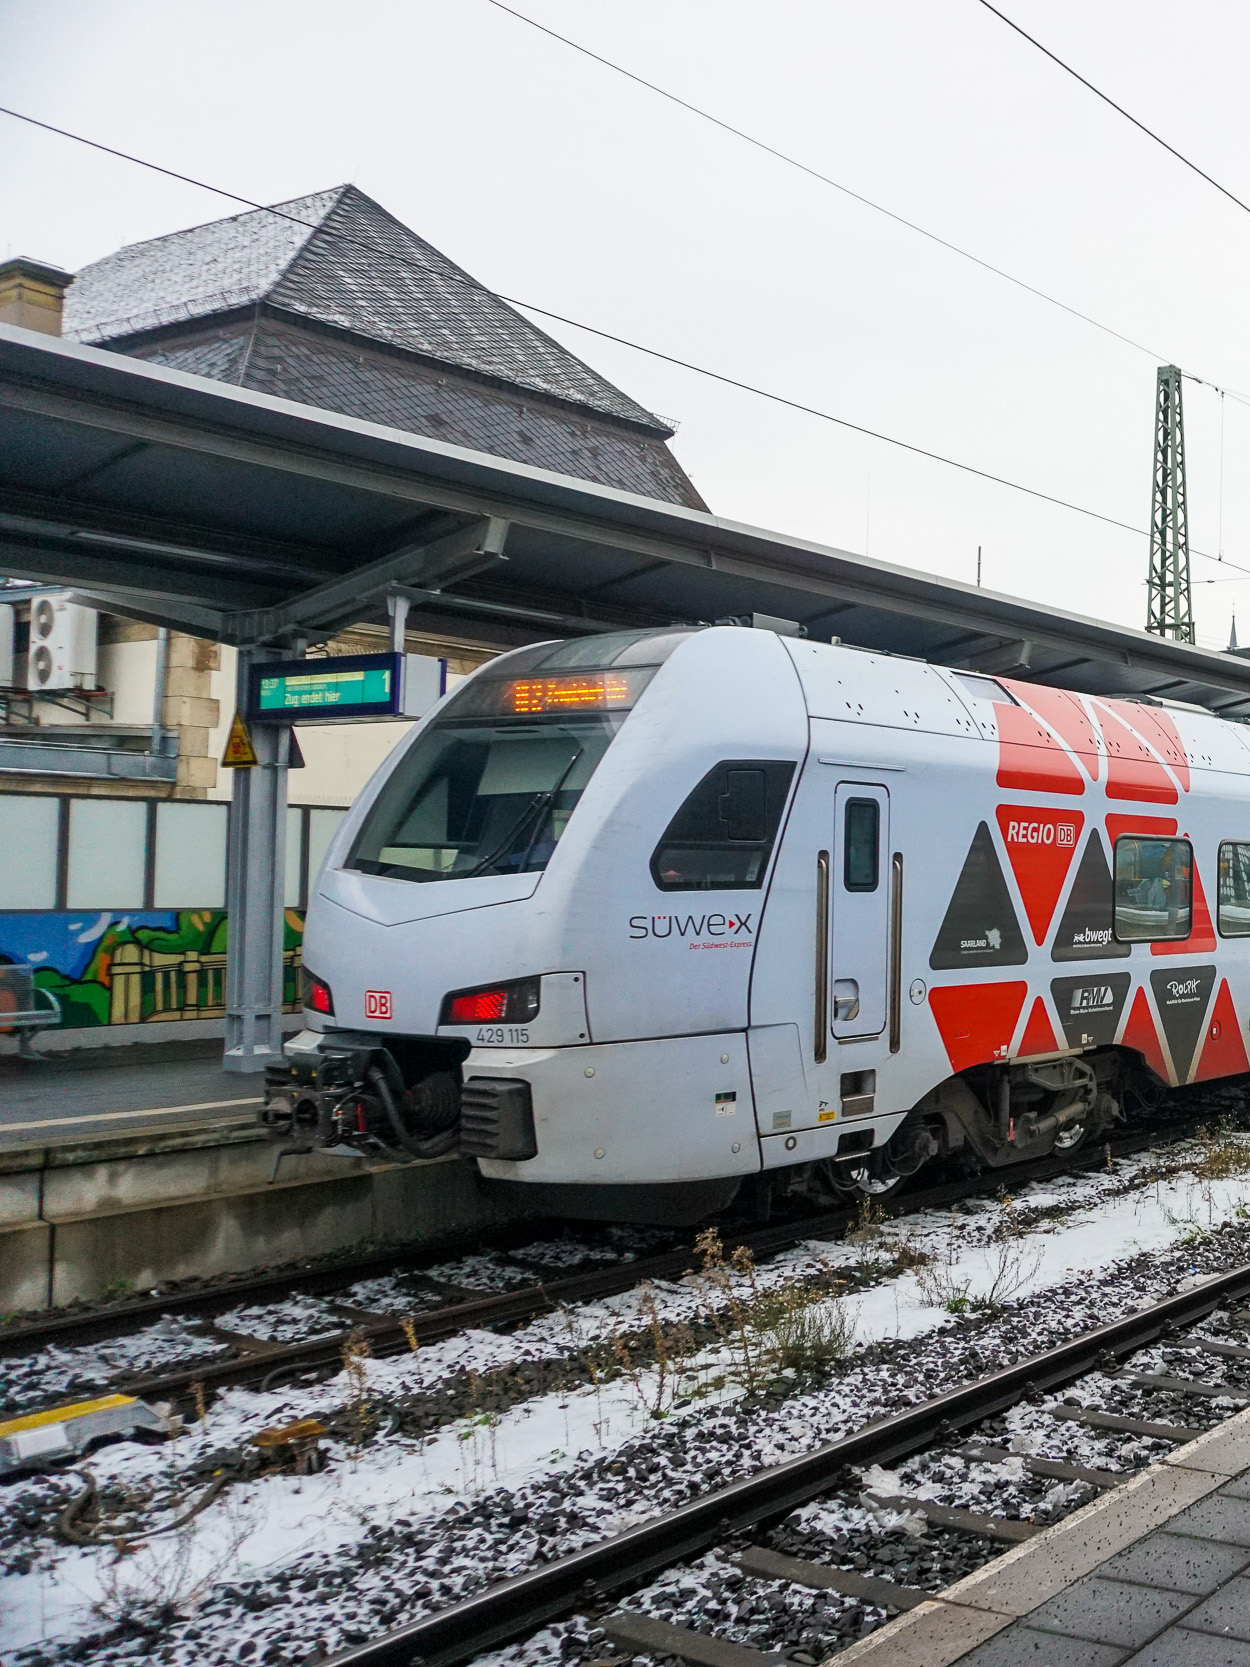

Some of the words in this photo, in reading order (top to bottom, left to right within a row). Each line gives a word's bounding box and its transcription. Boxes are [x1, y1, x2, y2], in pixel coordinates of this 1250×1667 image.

[382, 670, 390, 693] 1
[285, 693, 299, 707] Zug
[301, 691, 322, 704] endet
[325, 690, 340, 703] hier
[1007, 821, 1055, 845] REGIO
[1058, 826, 1074, 845] DB
[960, 939, 987, 948] SAARLAND
[1085, 927, 1113, 945] bwegt
[689, 942, 700, 950] Der
[367, 993, 390, 1016] DB
[1080, 986, 1109, 1007] RMV
[476, 1028, 504, 1044] 429
[508, 1028, 529, 1044] 115
